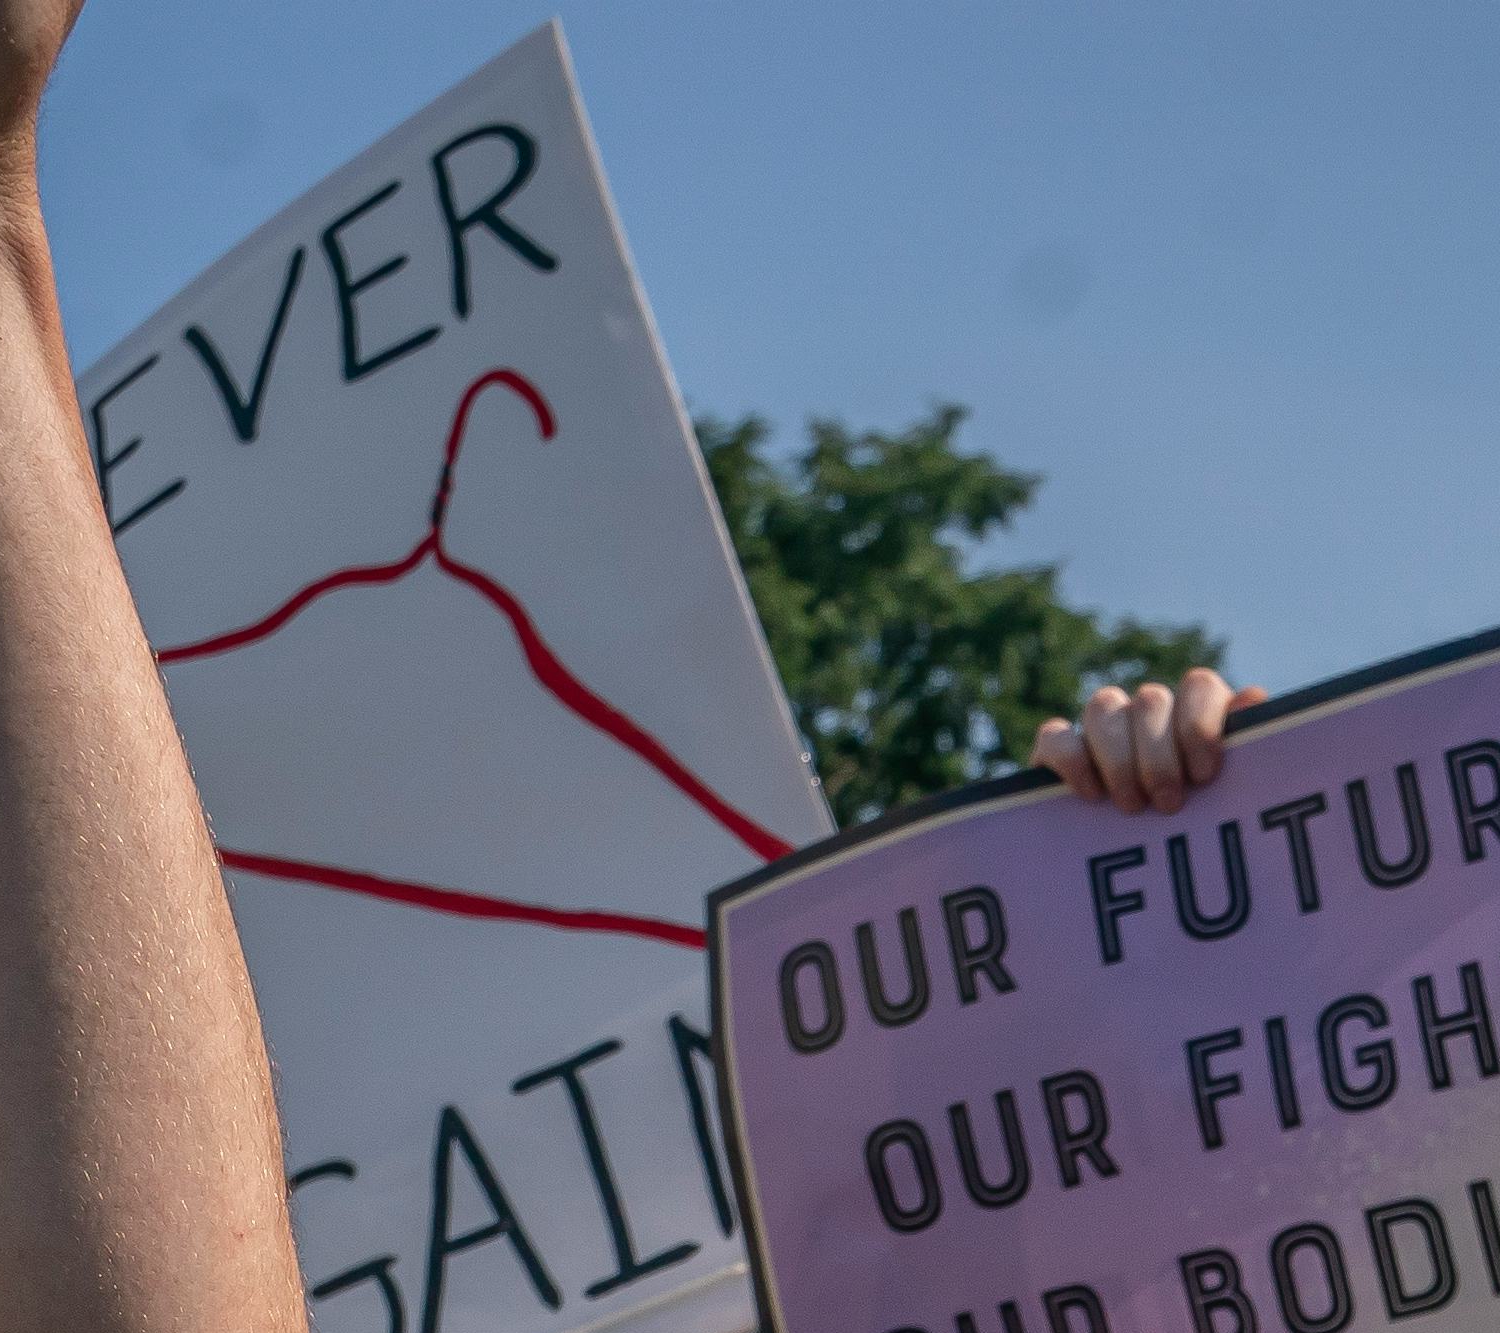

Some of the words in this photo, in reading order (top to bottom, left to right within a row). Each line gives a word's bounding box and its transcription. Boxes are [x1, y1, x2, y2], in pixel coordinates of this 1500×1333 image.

[91, 123, 560, 538] EVER
[778, 883, 1019, 1056] OUR
[864, 1068, 1121, 1235] OUR
